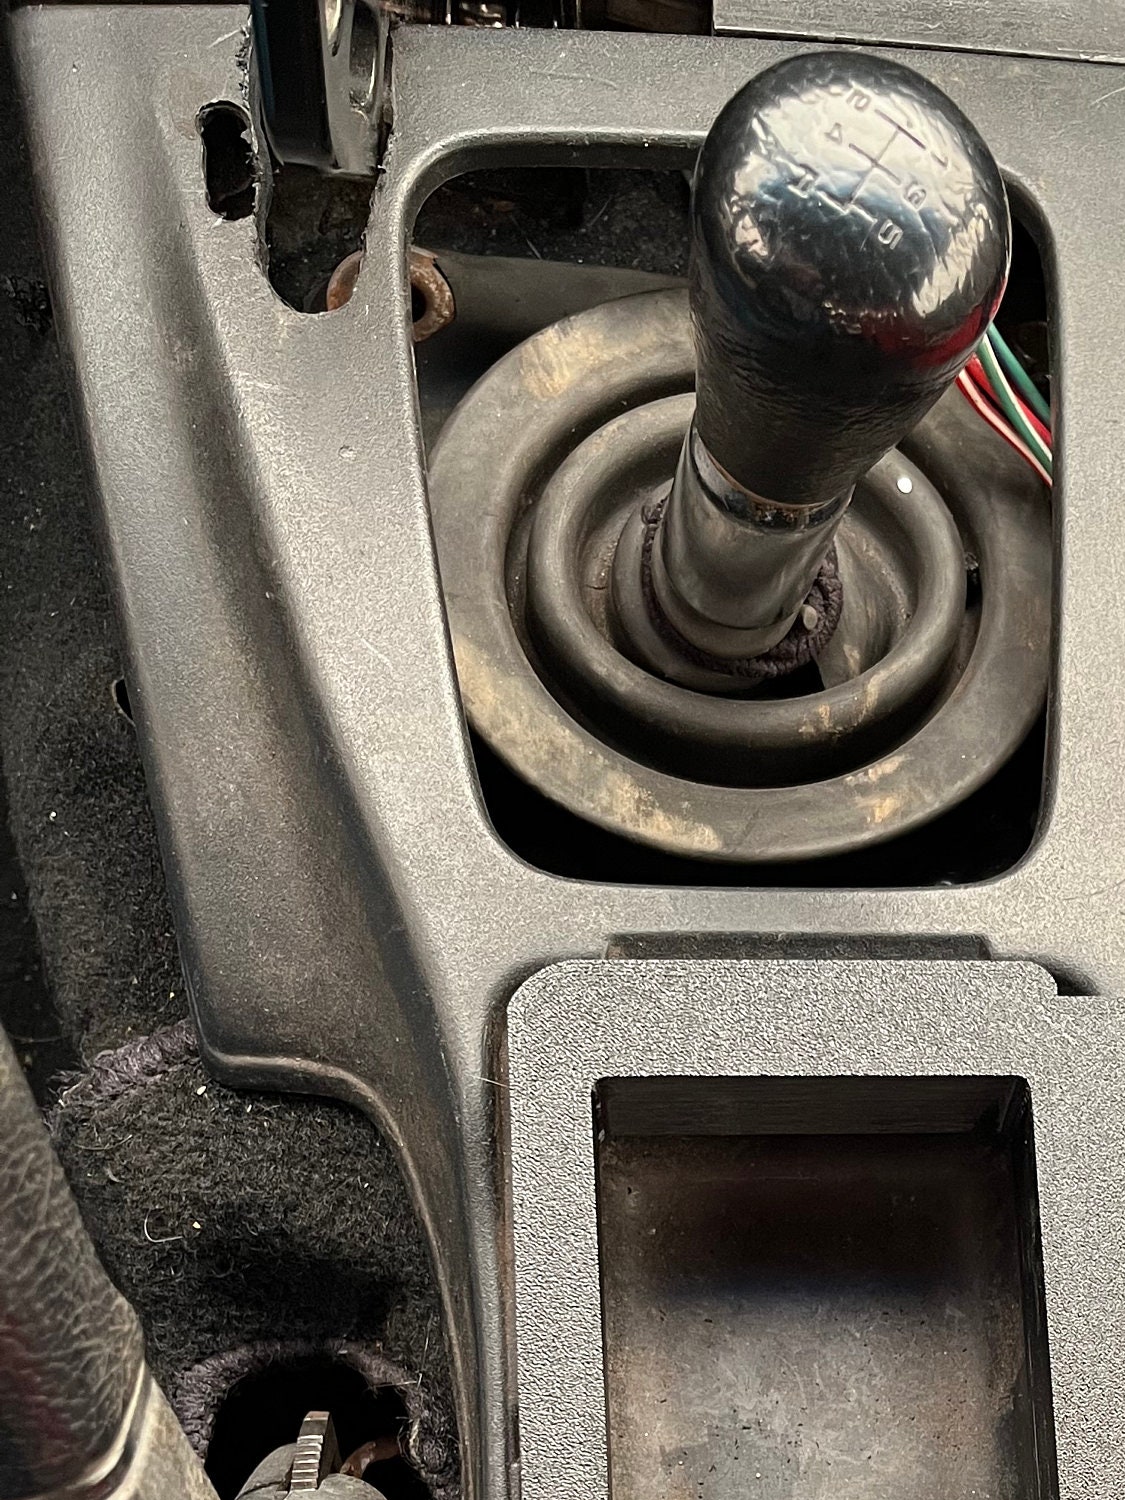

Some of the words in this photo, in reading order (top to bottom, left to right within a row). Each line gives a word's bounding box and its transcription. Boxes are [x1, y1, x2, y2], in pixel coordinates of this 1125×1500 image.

[847, 88, 872, 112] 2
[823, 122, 842, 145] 4
[877, 217, 904, 250] 5
